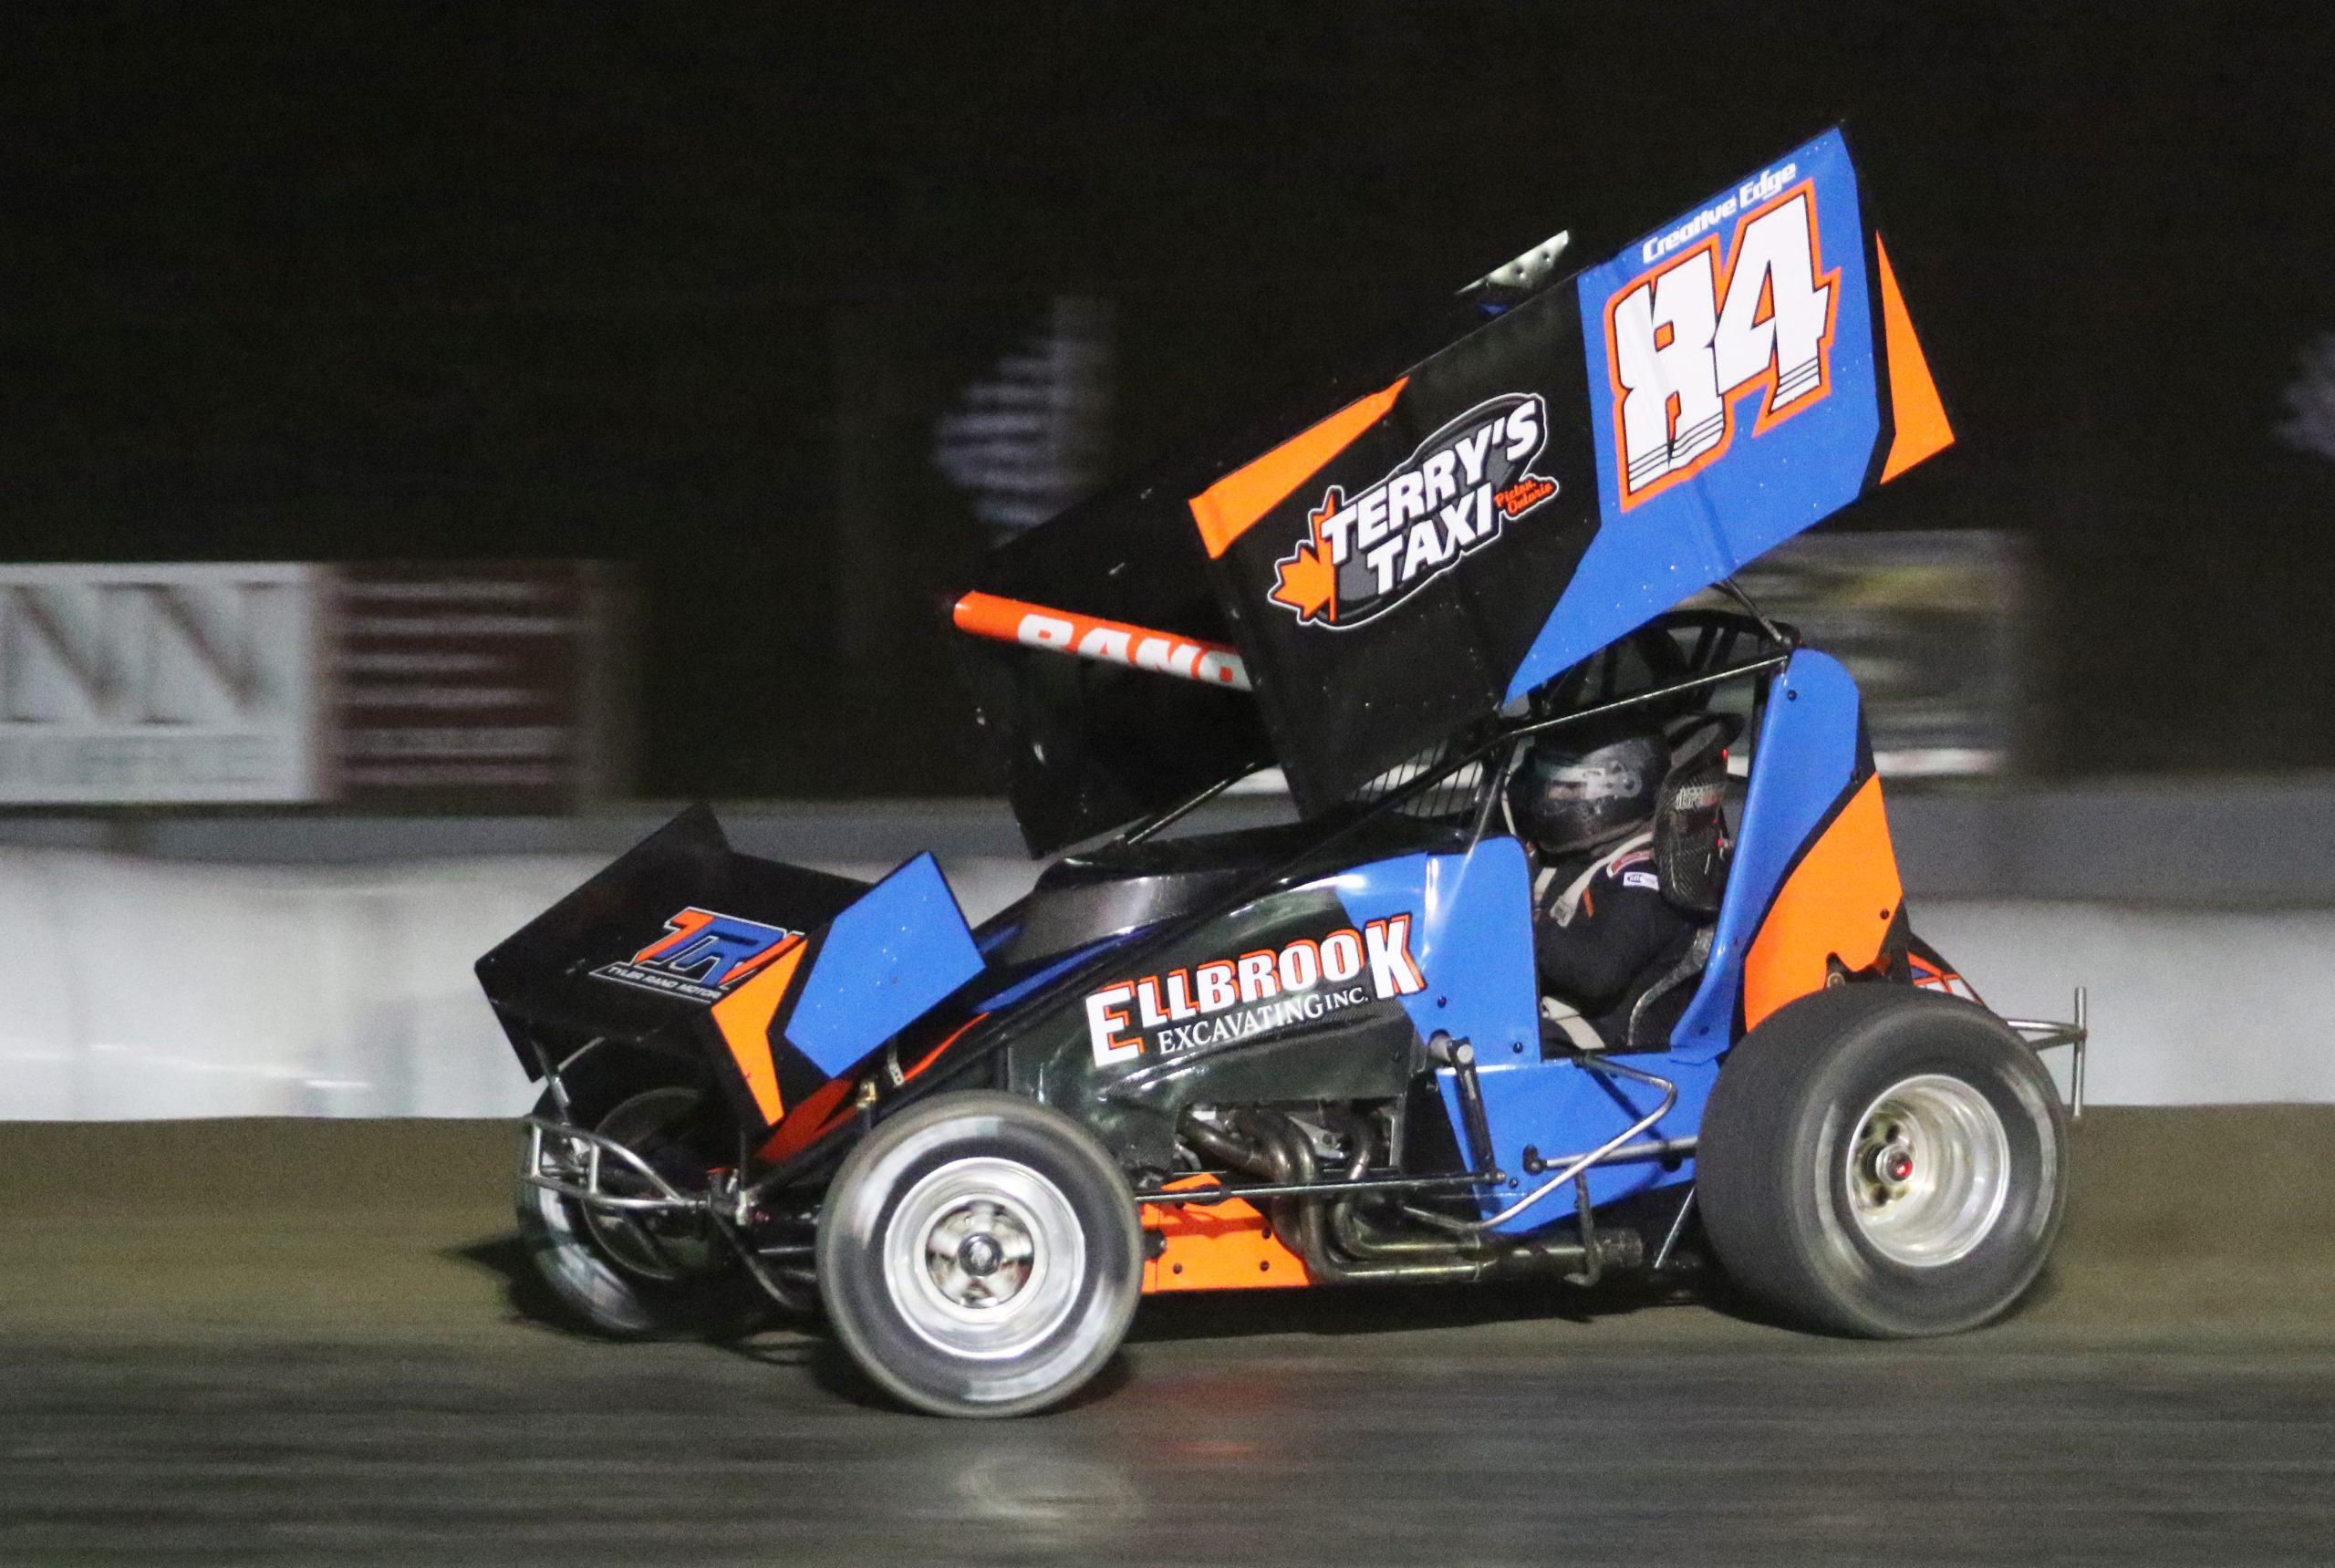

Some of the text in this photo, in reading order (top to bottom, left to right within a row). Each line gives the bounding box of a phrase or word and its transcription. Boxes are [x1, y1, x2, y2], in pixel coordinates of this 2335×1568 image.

[1643, 162, 1797, 264] Creative Edge
[1608, 185, 1836, 504] 84
[1321, 400, 1536, 565] TERRY'S
[1367, 482, 1492, 595] TAXI
[607, 966, 644, 981] TYLER
[1084, 913, 1429, 1068] ELLBROOK
[1157, 986, 1369, 1055] EXCAVATING INC.
